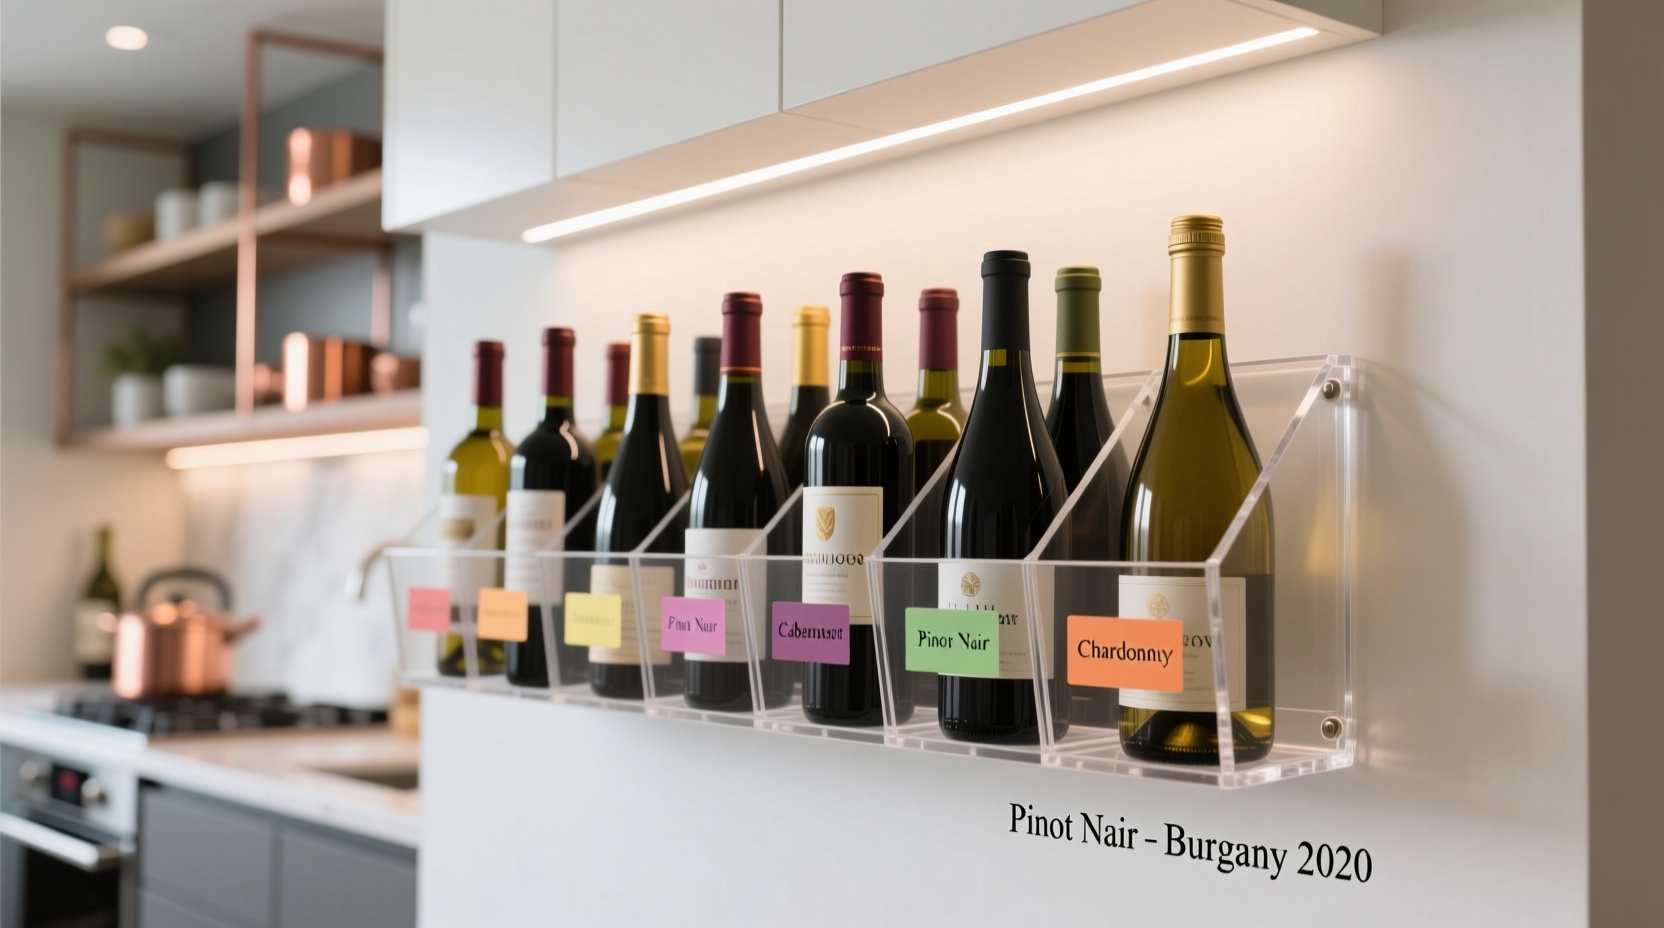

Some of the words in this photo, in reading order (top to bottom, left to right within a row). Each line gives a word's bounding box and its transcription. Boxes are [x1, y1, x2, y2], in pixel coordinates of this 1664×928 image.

[1009, 802, 1074, 842] Pinot
[1080, 812, 1139, 850] Nair
[1164, 822, 1288, 881] Burgany
[1297, 840, 1373, 884] 2020
